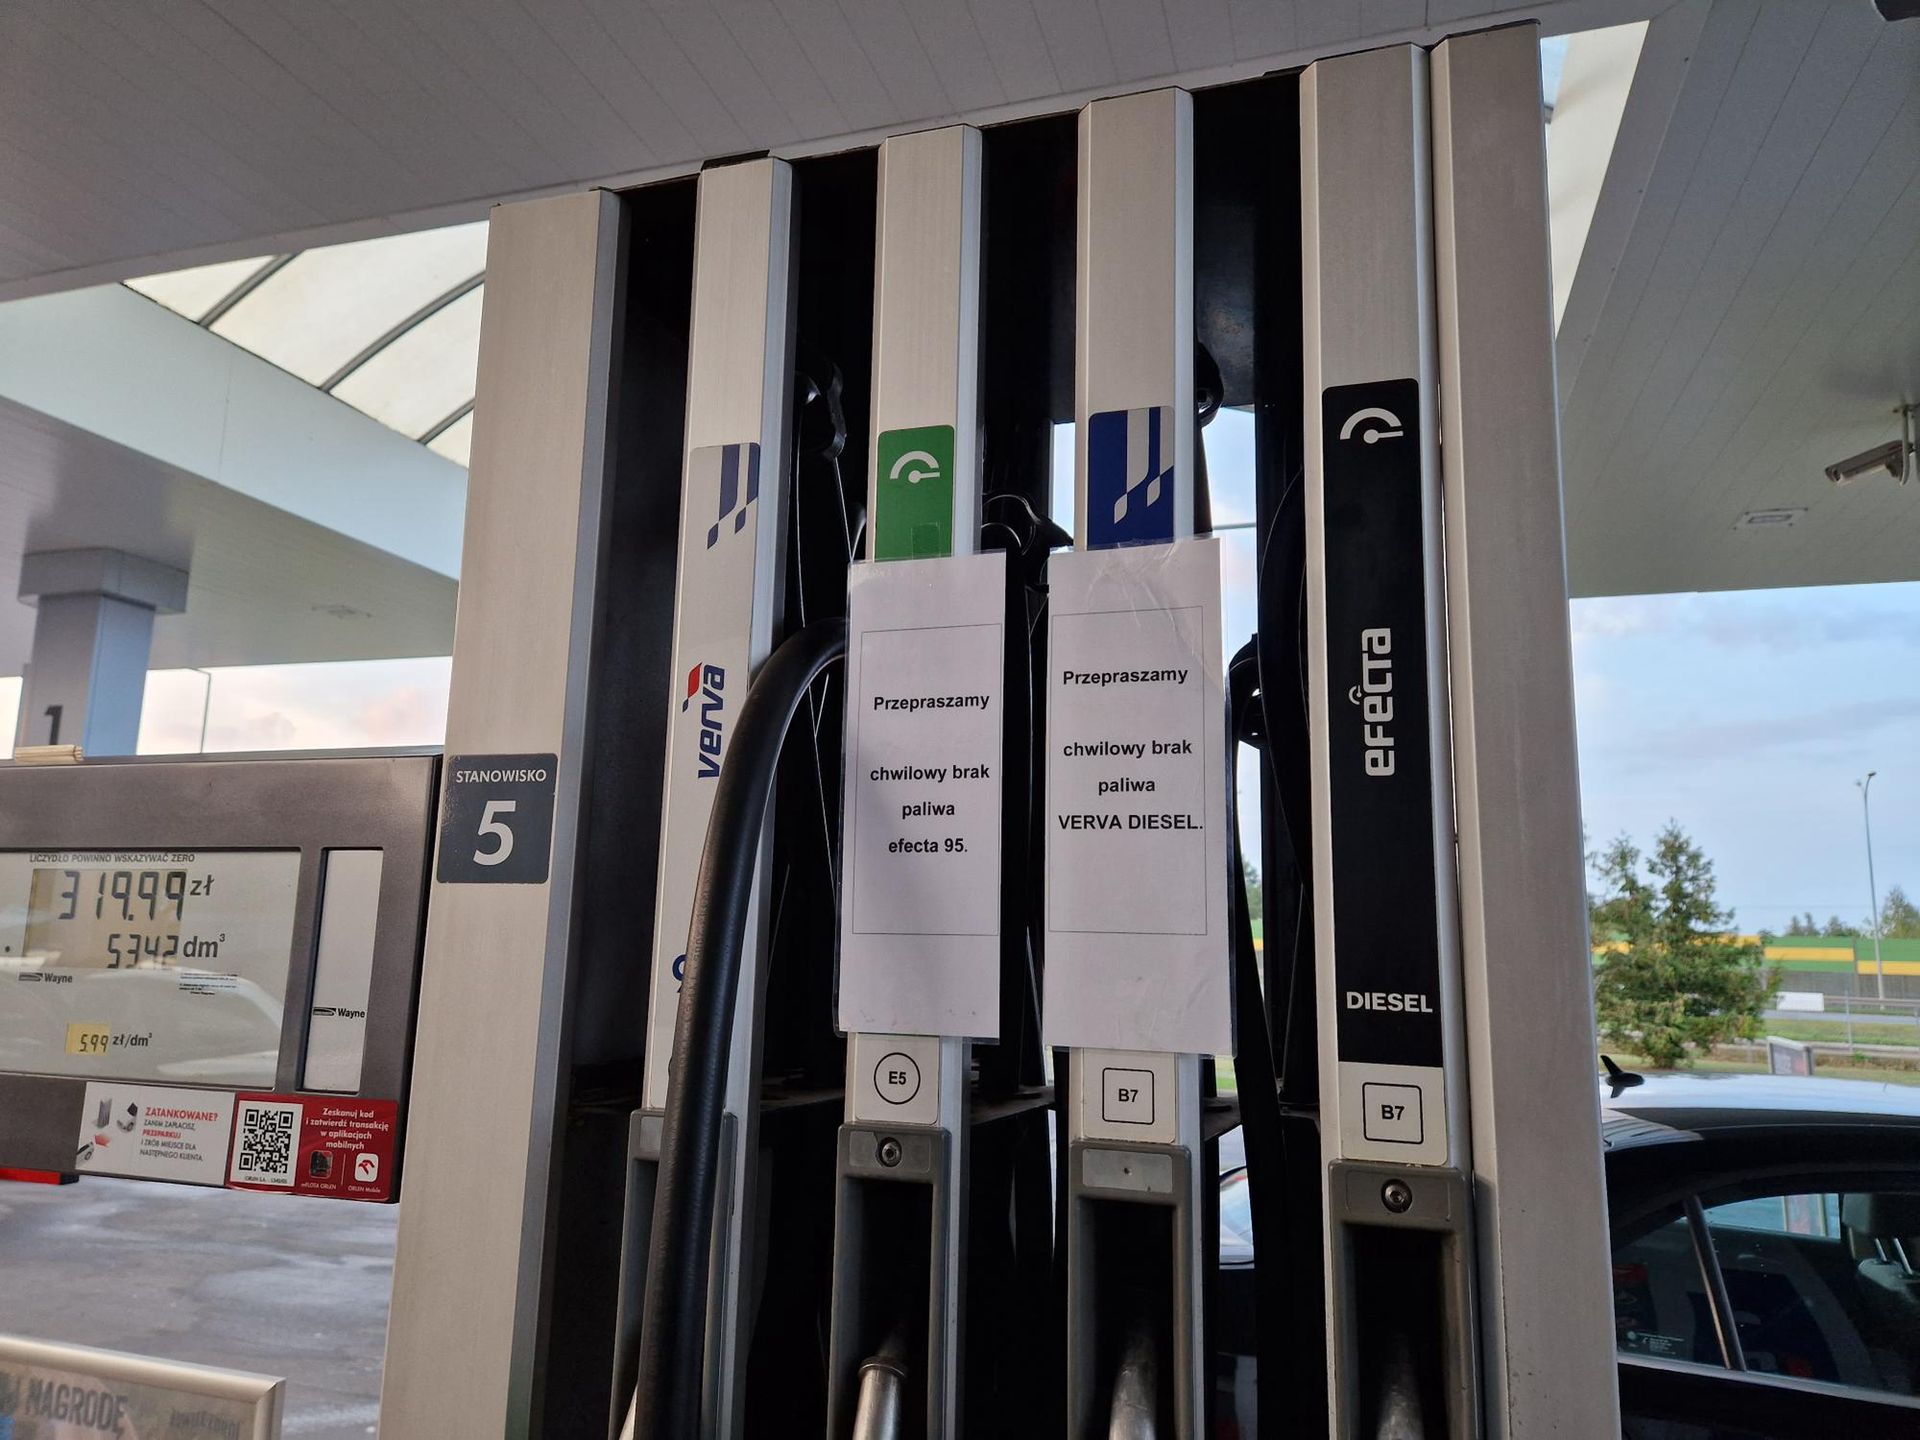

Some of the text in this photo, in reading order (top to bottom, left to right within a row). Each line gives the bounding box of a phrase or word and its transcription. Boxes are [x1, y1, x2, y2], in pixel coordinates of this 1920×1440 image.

[1063, 669, 1188, 687] Przepraszamy
[874, 695, 989, 712] Przepraszamy
[1362, 628, 1395, 776] efecta
[44, 705, 63, 745] 1
[698, 664, 725, 778] verva
[1063, 740, 1192, 758] chwilowy brak
[456, 769, 547, 783] STANOWISKO
[870, 764, 990, 783] chwilowy brak
[1098, 778, 1155, 796] paliwa
[902, 802, 955, 819] paliwa
[1058, 815, 1203, 830] VERVA DIESEL.
[473, 800, 516, 866] 5
[888, 838, 968, 853] efecta 95.
[72, 854, 112, 863] POWINNO
[171, 853, 195, 863] ZERO
[58, 871, 215, 921] 319.99 zł
[44, 973, 73, 984] Wayne
[1346, 991, 1433, 1013] DIESEL
[338, 1007, 366, 1019] Wayne
[888, 1071, 907, 1085] E5
[1118, 1088, 1139, 1103] B7
[145, 1106, 218, 1121] ZATANKOWANE?
[322, 1107, 375, 1118] Zeskanuj kod
[1381, 1104, 1405, 1120] B7
[310, 1118, 348, 1127] zatwierdź
[349, 1120, 389, 1131] transakcję
[328, 1129, 372, 1140] aplikacjach
[185, 1143, 197, 1151] DLA
[325, 1140, 365, 1151] mobilnych
